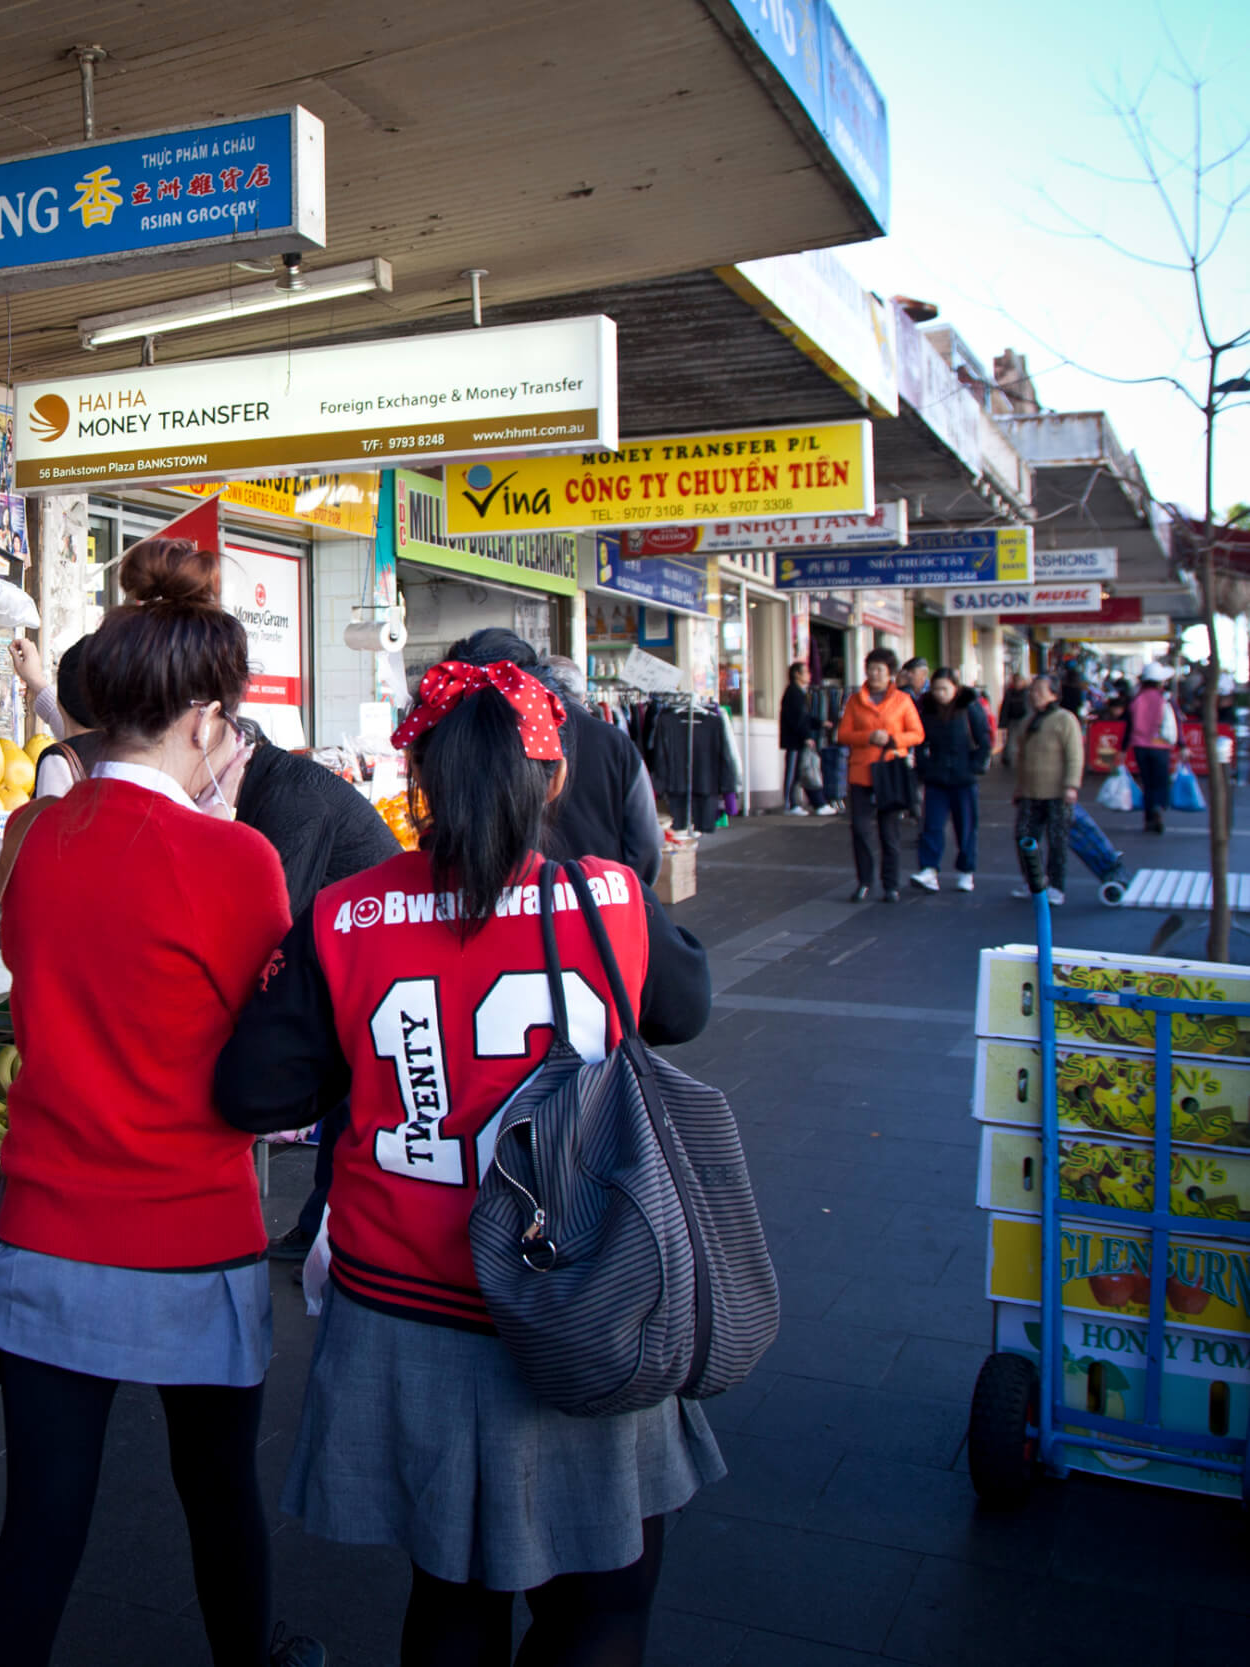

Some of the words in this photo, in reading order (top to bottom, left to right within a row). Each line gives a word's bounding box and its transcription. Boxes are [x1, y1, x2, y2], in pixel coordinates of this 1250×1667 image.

[68, 165, 124, 229] 香
[141, 211, 182, 230] ASIAN
[187, 200, 258, 224] GROCERY
[78, 391, 112, 414] HAI
[118, 389, 148, 409] HA
[320, 399, 374, 415] Foreign
[377, 393, 448, 410] Exchange
[451, 390, 462, 402] &
[466, 385, 518, 402] Money
[520, 377, 585, 395] Transfer
[77, 412, 152, 439] MONEY
[158, 400, 270, 430] TRANSFER
[472, 422, 586, 442] www.hhmt.com.au
[388, 436, 416, 450] 9793
[418, 433, 446, 448] 8248
[581, 447, 654, 466] MONEY
[662, 438, 778, 461] TRANSFER
[788, 435, 822, 452] P/L
[39, 467, 51, 480] 56
[53, 462, 107, 478] Bankstown
[108, 461, 136, 473] Plaza
[137, 453, 208, 471] BANKSTOWN
[565, 472, 632, 504] CÔNG
[639, 471, 670, 499] TY
[623, 506, 652, 520] 9707
[655, 503, 685, 518] 3108
[694, 501, 719, 516] FAX
[729, 499, 759, 514] 9707
[763, 497, 794, 512] 3308
[953, 591, 1030, 610] SAIGON
[400, 1010, 441, 1167] TWENTY
[1082, 1322, 1182, 1360] HONY
